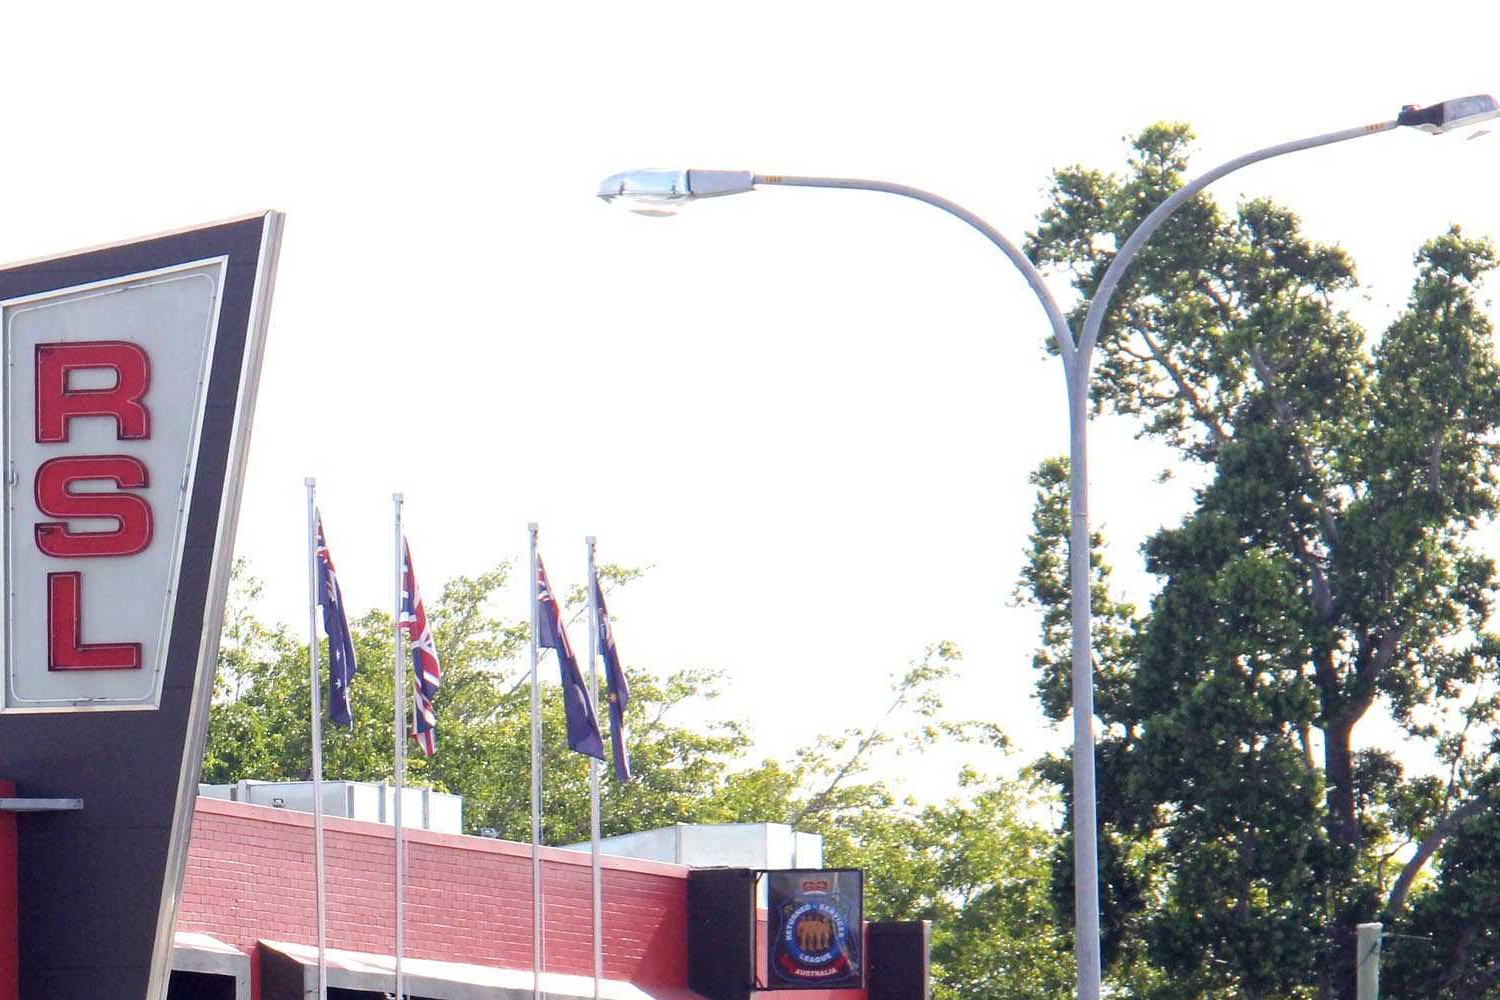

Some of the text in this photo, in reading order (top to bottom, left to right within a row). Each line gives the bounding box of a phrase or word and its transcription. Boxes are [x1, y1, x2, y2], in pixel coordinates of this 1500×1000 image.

[35, 340, 153, 672] RSL
[799, 953, 833, 963] LEAGUE
[794, 967, 838, 977] AUSTRALIA
